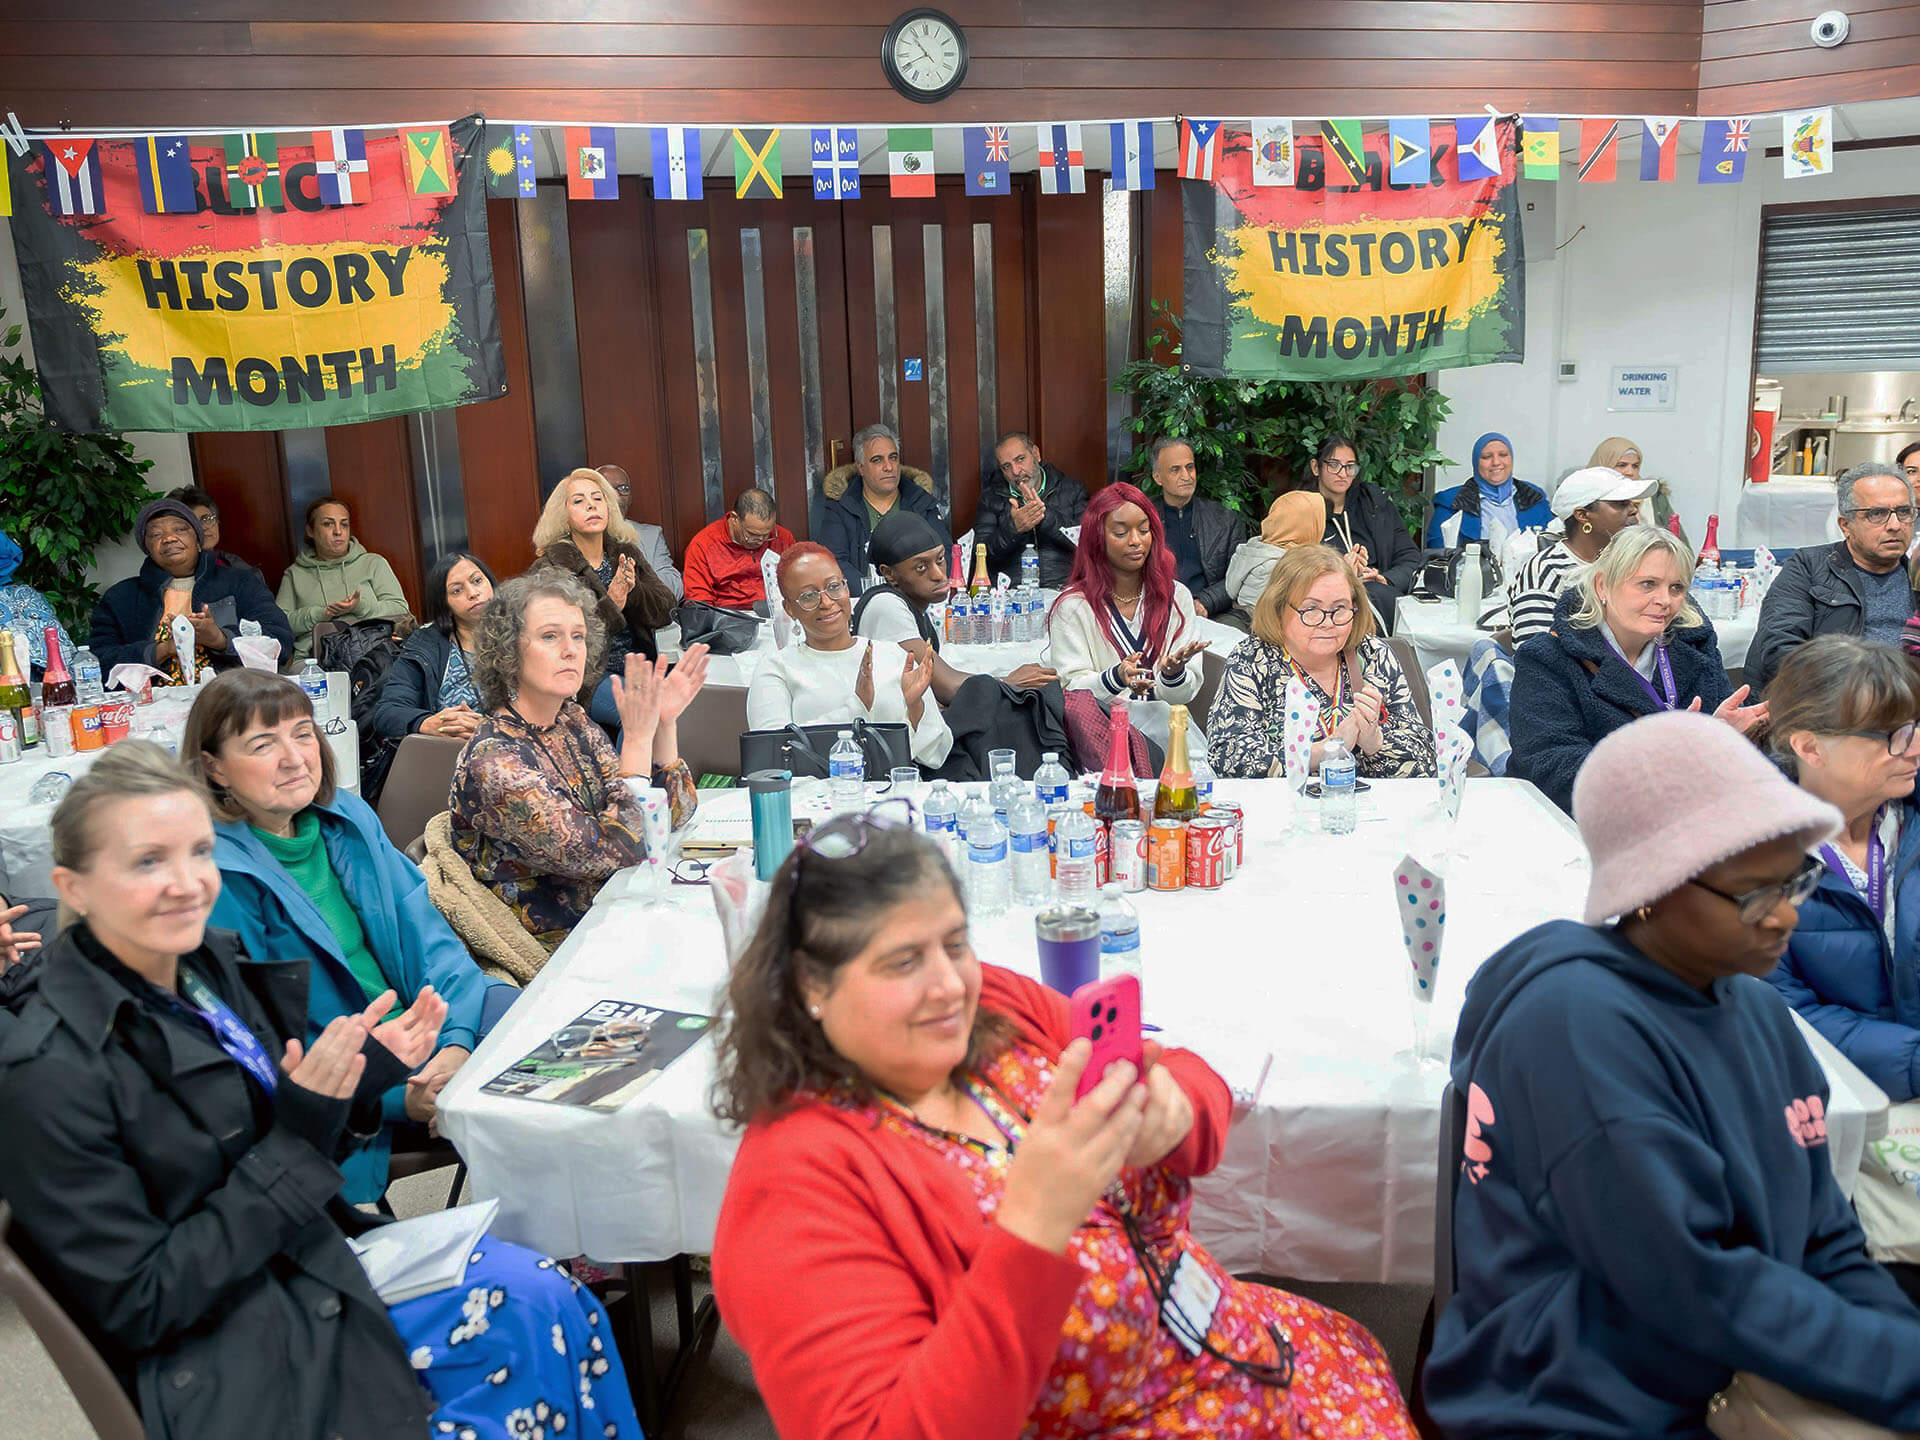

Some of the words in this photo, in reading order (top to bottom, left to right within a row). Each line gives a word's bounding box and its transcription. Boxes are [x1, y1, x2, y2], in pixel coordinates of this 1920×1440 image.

[1295, 145, 1449, 193] BAK
[1268, 219, 1477, 276] HISTORY
[137, 247, 413, 312] HISTORY
[1279, 306, 1447, 360] MONTH
[171, 344, 396, 406] MONTH
[1618, 387, 1651, 395] WATER
[1622, 373, 1667, 382] DRINKING
[82, 713, 102, 729] FAN
